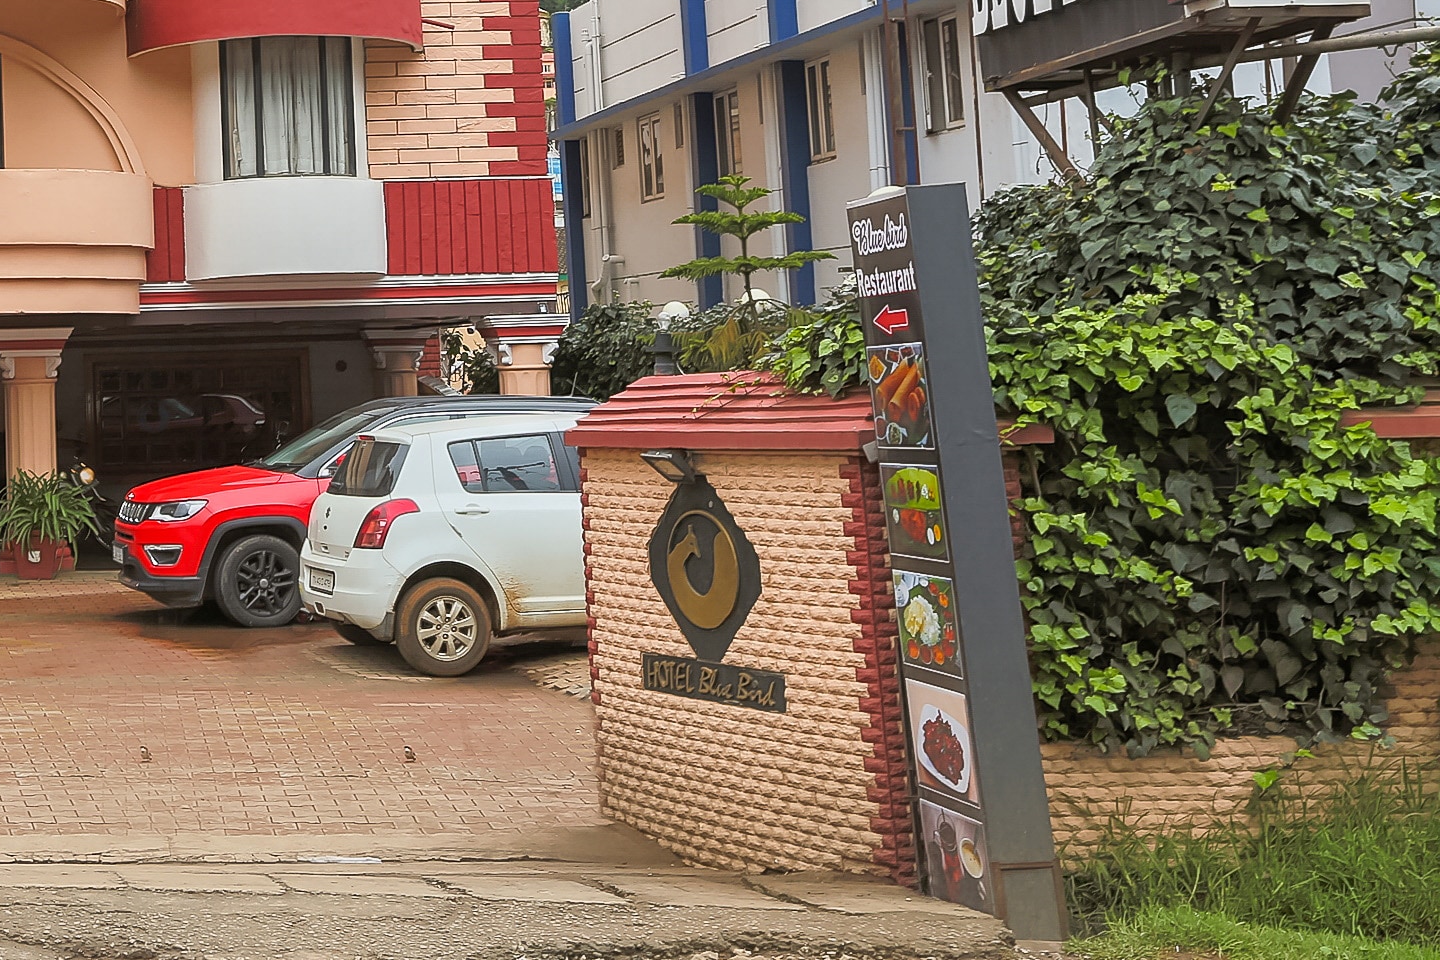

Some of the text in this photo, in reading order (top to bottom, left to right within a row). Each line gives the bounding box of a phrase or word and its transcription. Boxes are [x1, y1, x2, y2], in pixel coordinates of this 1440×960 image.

[856, 260, 917, 298] Restaurant
[647, 659, 695, 693] HOTEL
[736, 672, 776, 707] Bird
